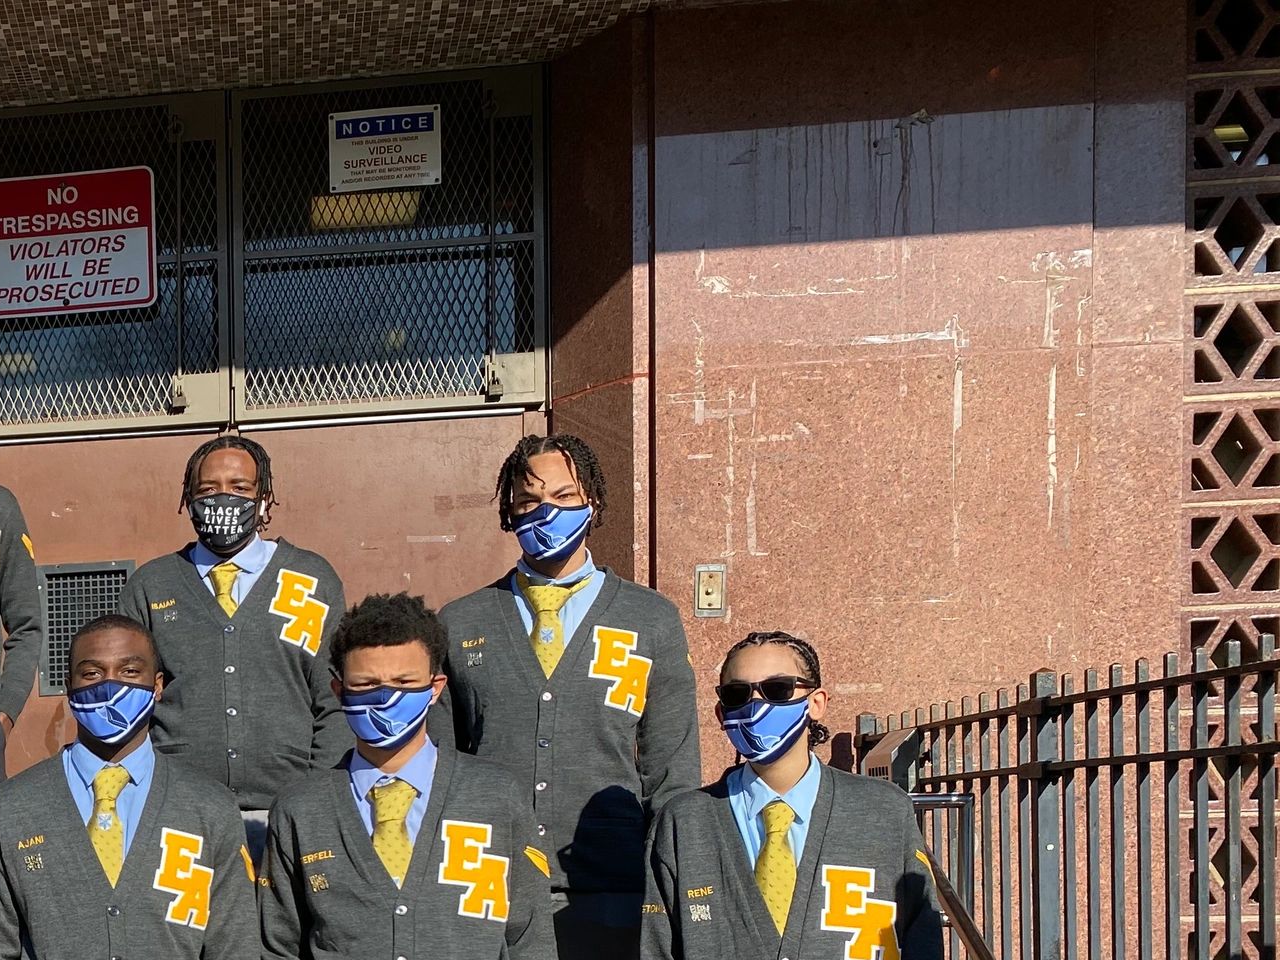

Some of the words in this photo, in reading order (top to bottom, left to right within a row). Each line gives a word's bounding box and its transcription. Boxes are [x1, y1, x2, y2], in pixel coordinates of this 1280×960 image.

[342, 116, 428, 135] NOTICE
[365, 137, 391, 145] BUILDING
[399, 135, 419, 143] UNDER
[368, 144, 402, 155] VIDEO
[343, 153, 428, 169] SURVEILLANCE
[341, 177, 363, 185] AND/OR
[364, 174, 395, 182] RECORDED
[47, 186, 79, 205] NO
[9, 234, 127, 261] VIOLATORS
[25, 261, 73, 281] WILL
[82, 257, 112, 277] BE
[203, 506, 241, 516] BLACK
[205, 515, 238, 525] LIVES
[200, 523, 244, 535] MATTER
[150, 598, 176, 610] ISAIAH
[18, 834, 45, 850] AJANI
[687, 885, 714, 899] RENE
